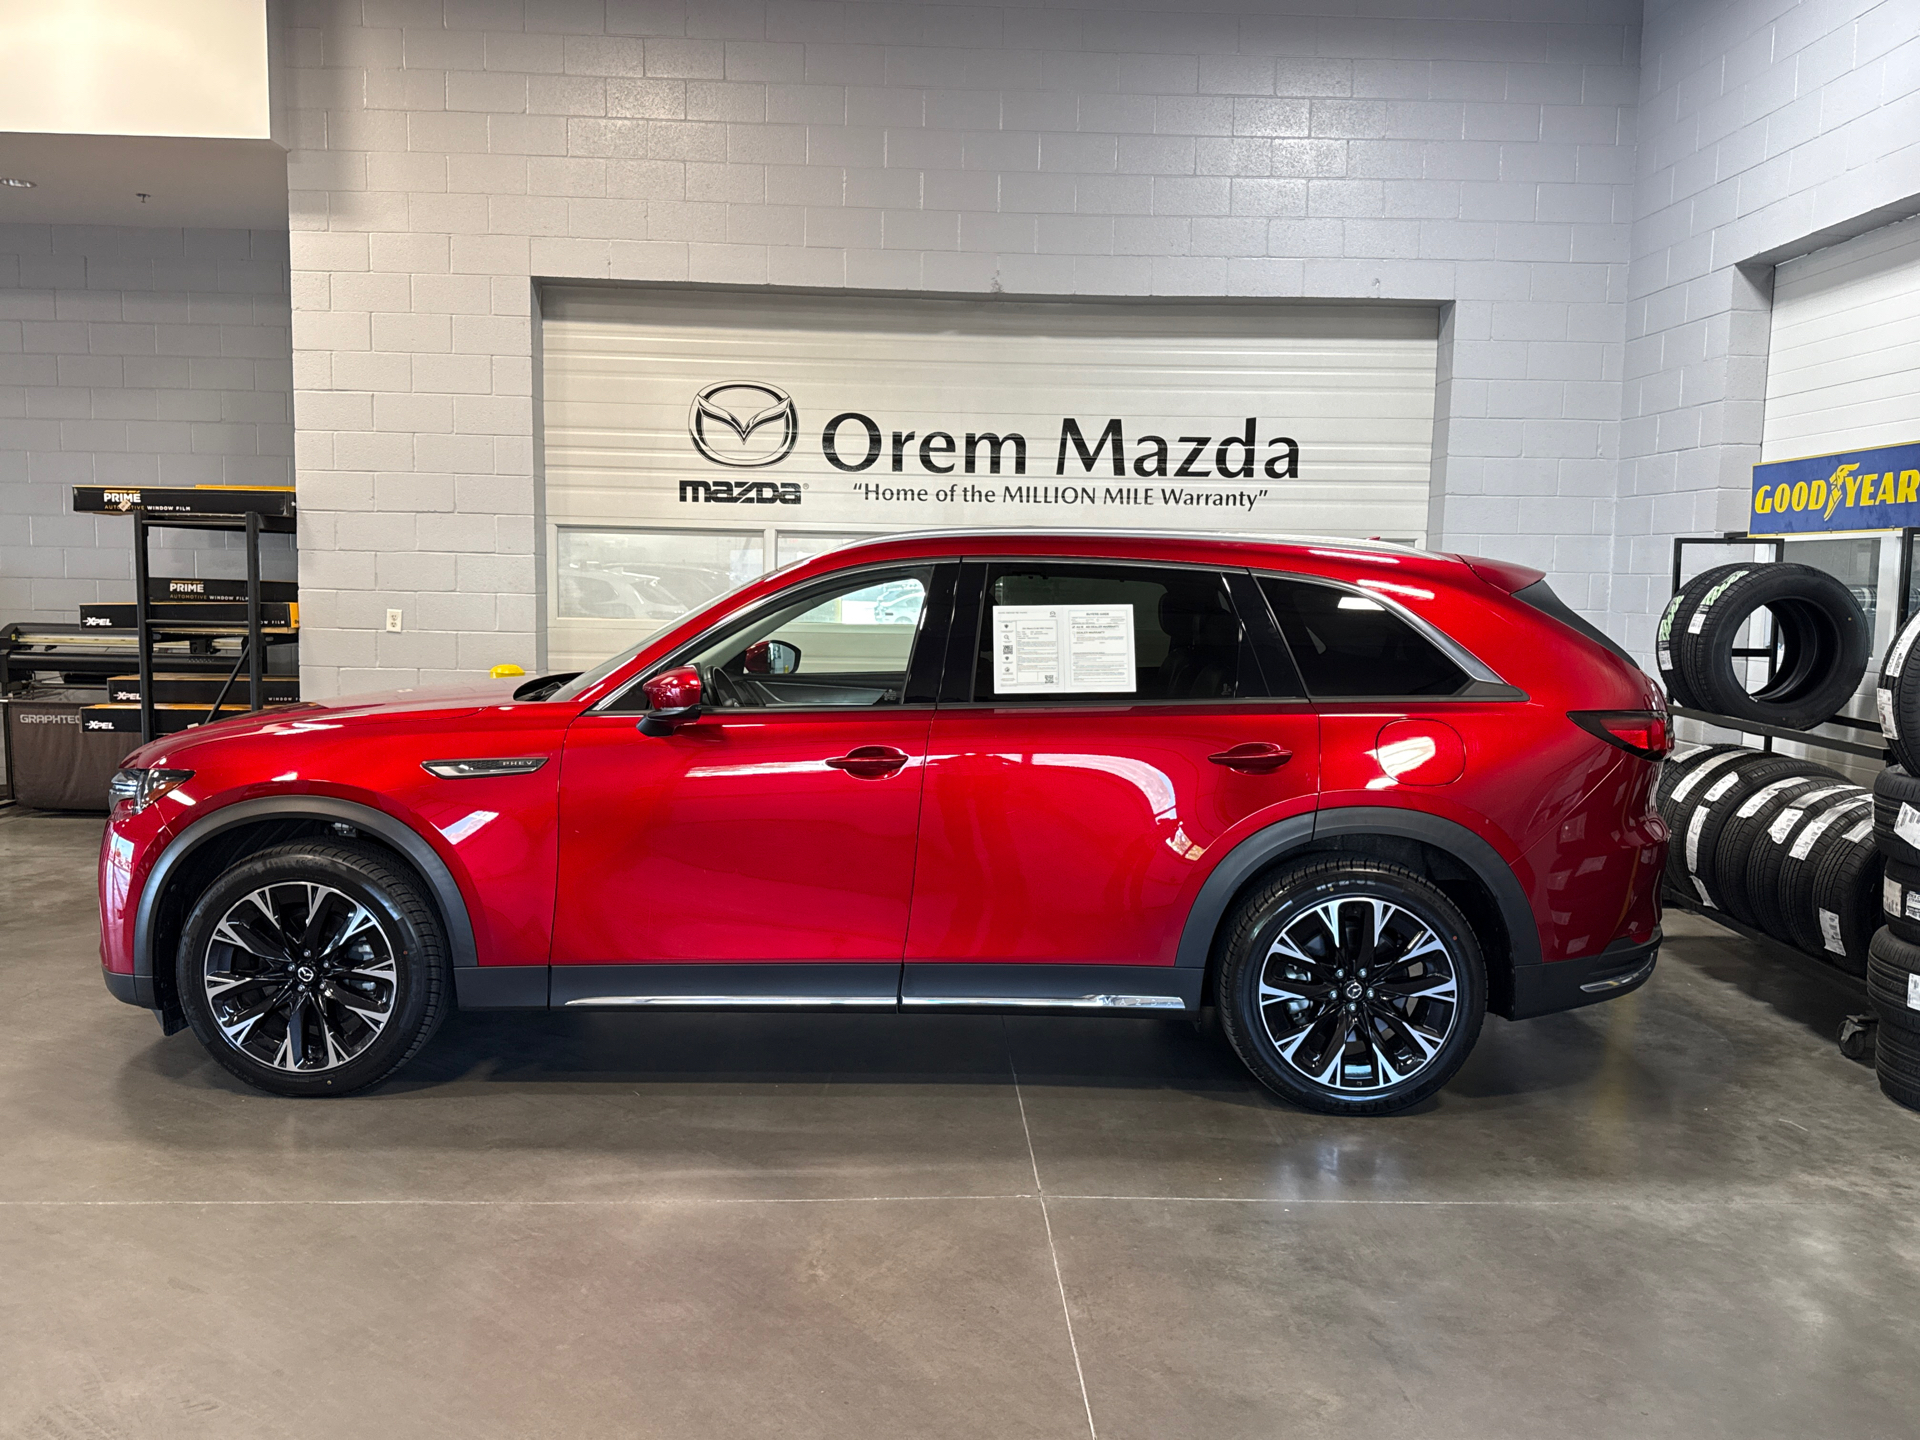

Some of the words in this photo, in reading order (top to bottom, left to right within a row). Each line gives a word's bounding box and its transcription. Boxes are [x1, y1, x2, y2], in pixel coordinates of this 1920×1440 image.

[822, 412, 1028, 475] Orem
[1056, 417, 1301, 479] Mazda
[935, 484, 957, 503] of
[962, 485, 996, 503] the
[1002, 485, 1096, 505] MILLION
[1103, 487, 1154, 506] MILE
[1754, 469, 1920, 514] GOODYEAR
[103, 493, 142, 503] PRIME
[169, 583, 205, 593] PRIME
[86, 616, 112, 626] XPEL
[117, 691, 142, 700] XPEL
[88, 720, 115, 730] XPEL
